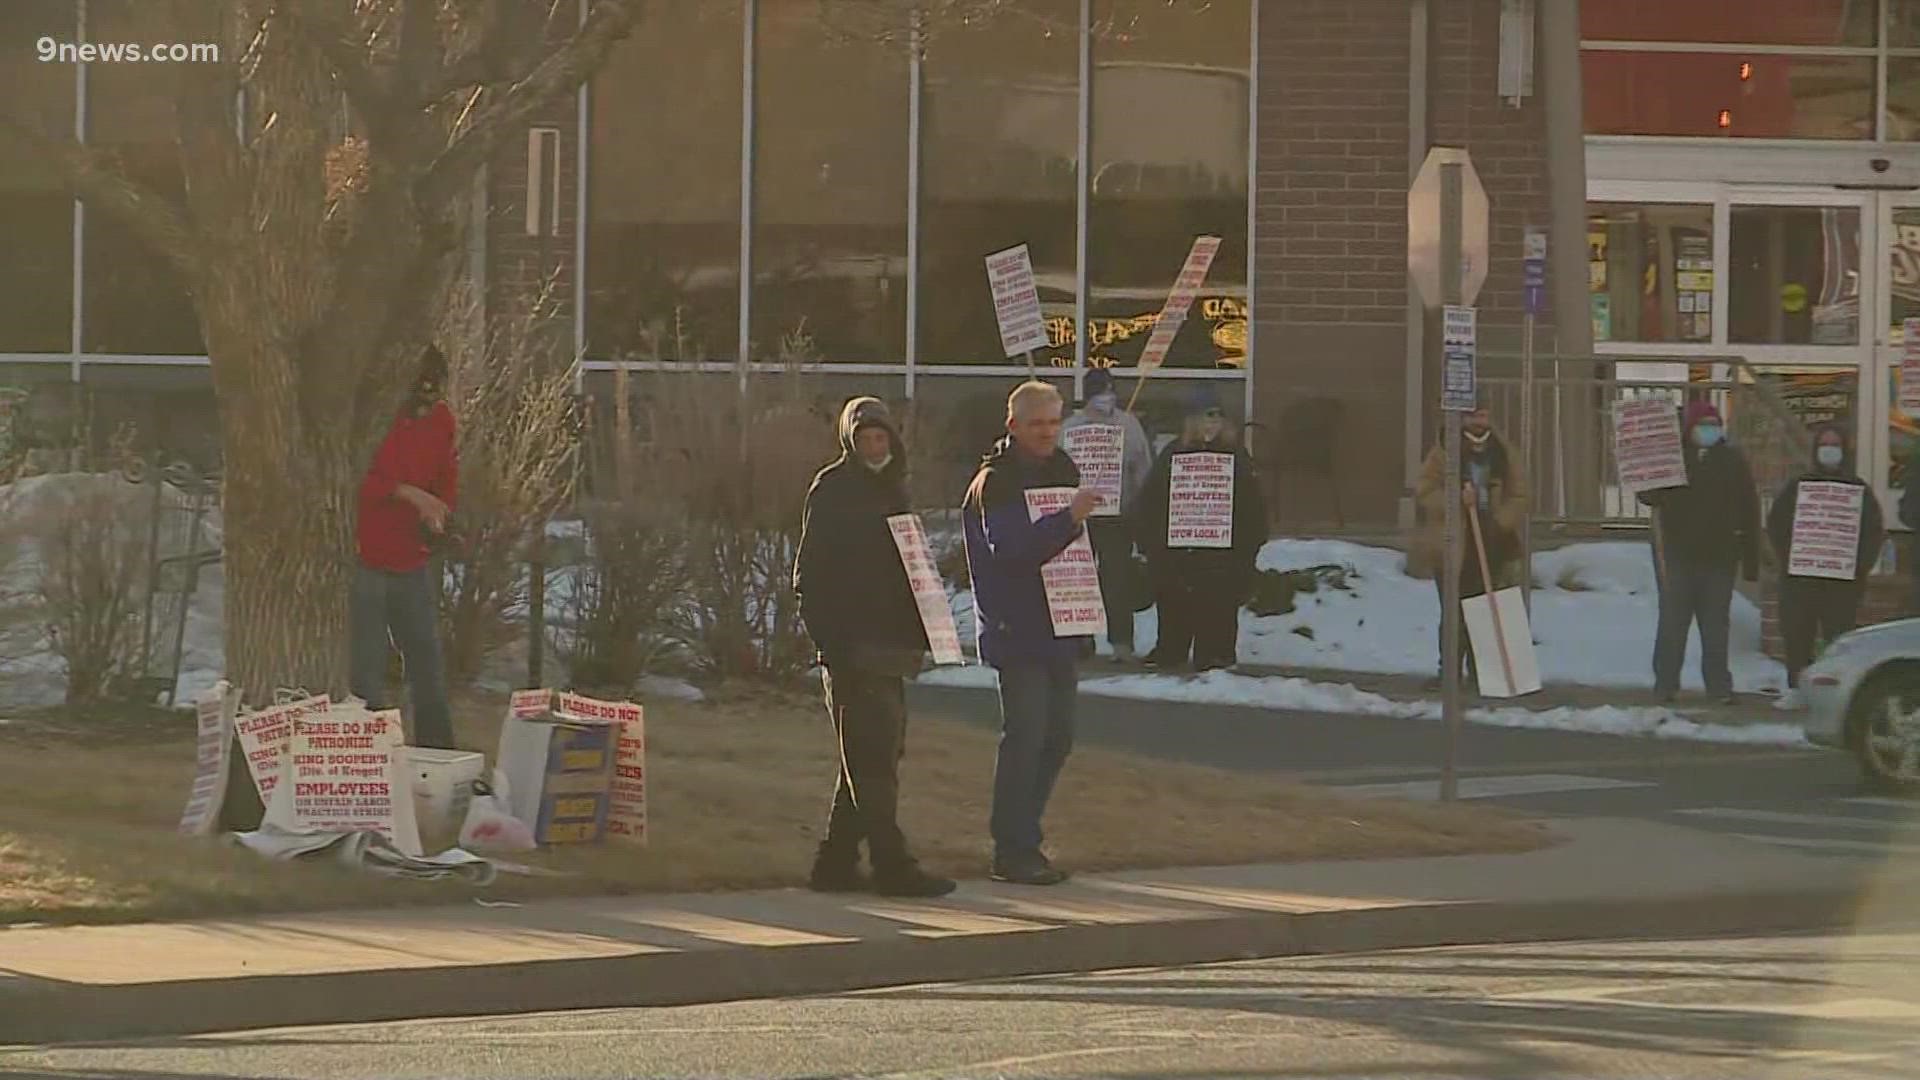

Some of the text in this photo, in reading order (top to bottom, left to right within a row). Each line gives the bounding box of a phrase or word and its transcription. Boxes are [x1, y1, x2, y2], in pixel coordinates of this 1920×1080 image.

[1028, 492, 1059, 505] PLEASE
[1194, 529, 1220, 538] LOCAL
[562, 699, 598, 716] PLEASE
[601, 707, 615, 718] DO
[618, 709, 641, 722] NOT
[240, 711, 284, 734] PLEASE
[294, 721, 388, 737] PLEASE DO NOT
[256, 726, 291, 744] PATRO
[308, 737, 374, 749] PATRONIZE
[249, 748, 278, 761] KING
[293, 754, 388, 765] KING SOOPER'S
[328, 766, 338, 776] of
[295, 783, 390, 796] EMPLOYEES
[296, 798, 392, 807] ON UNFAIR LABOR
[296, 808, 392, 817] PRACTICE STRIKE
